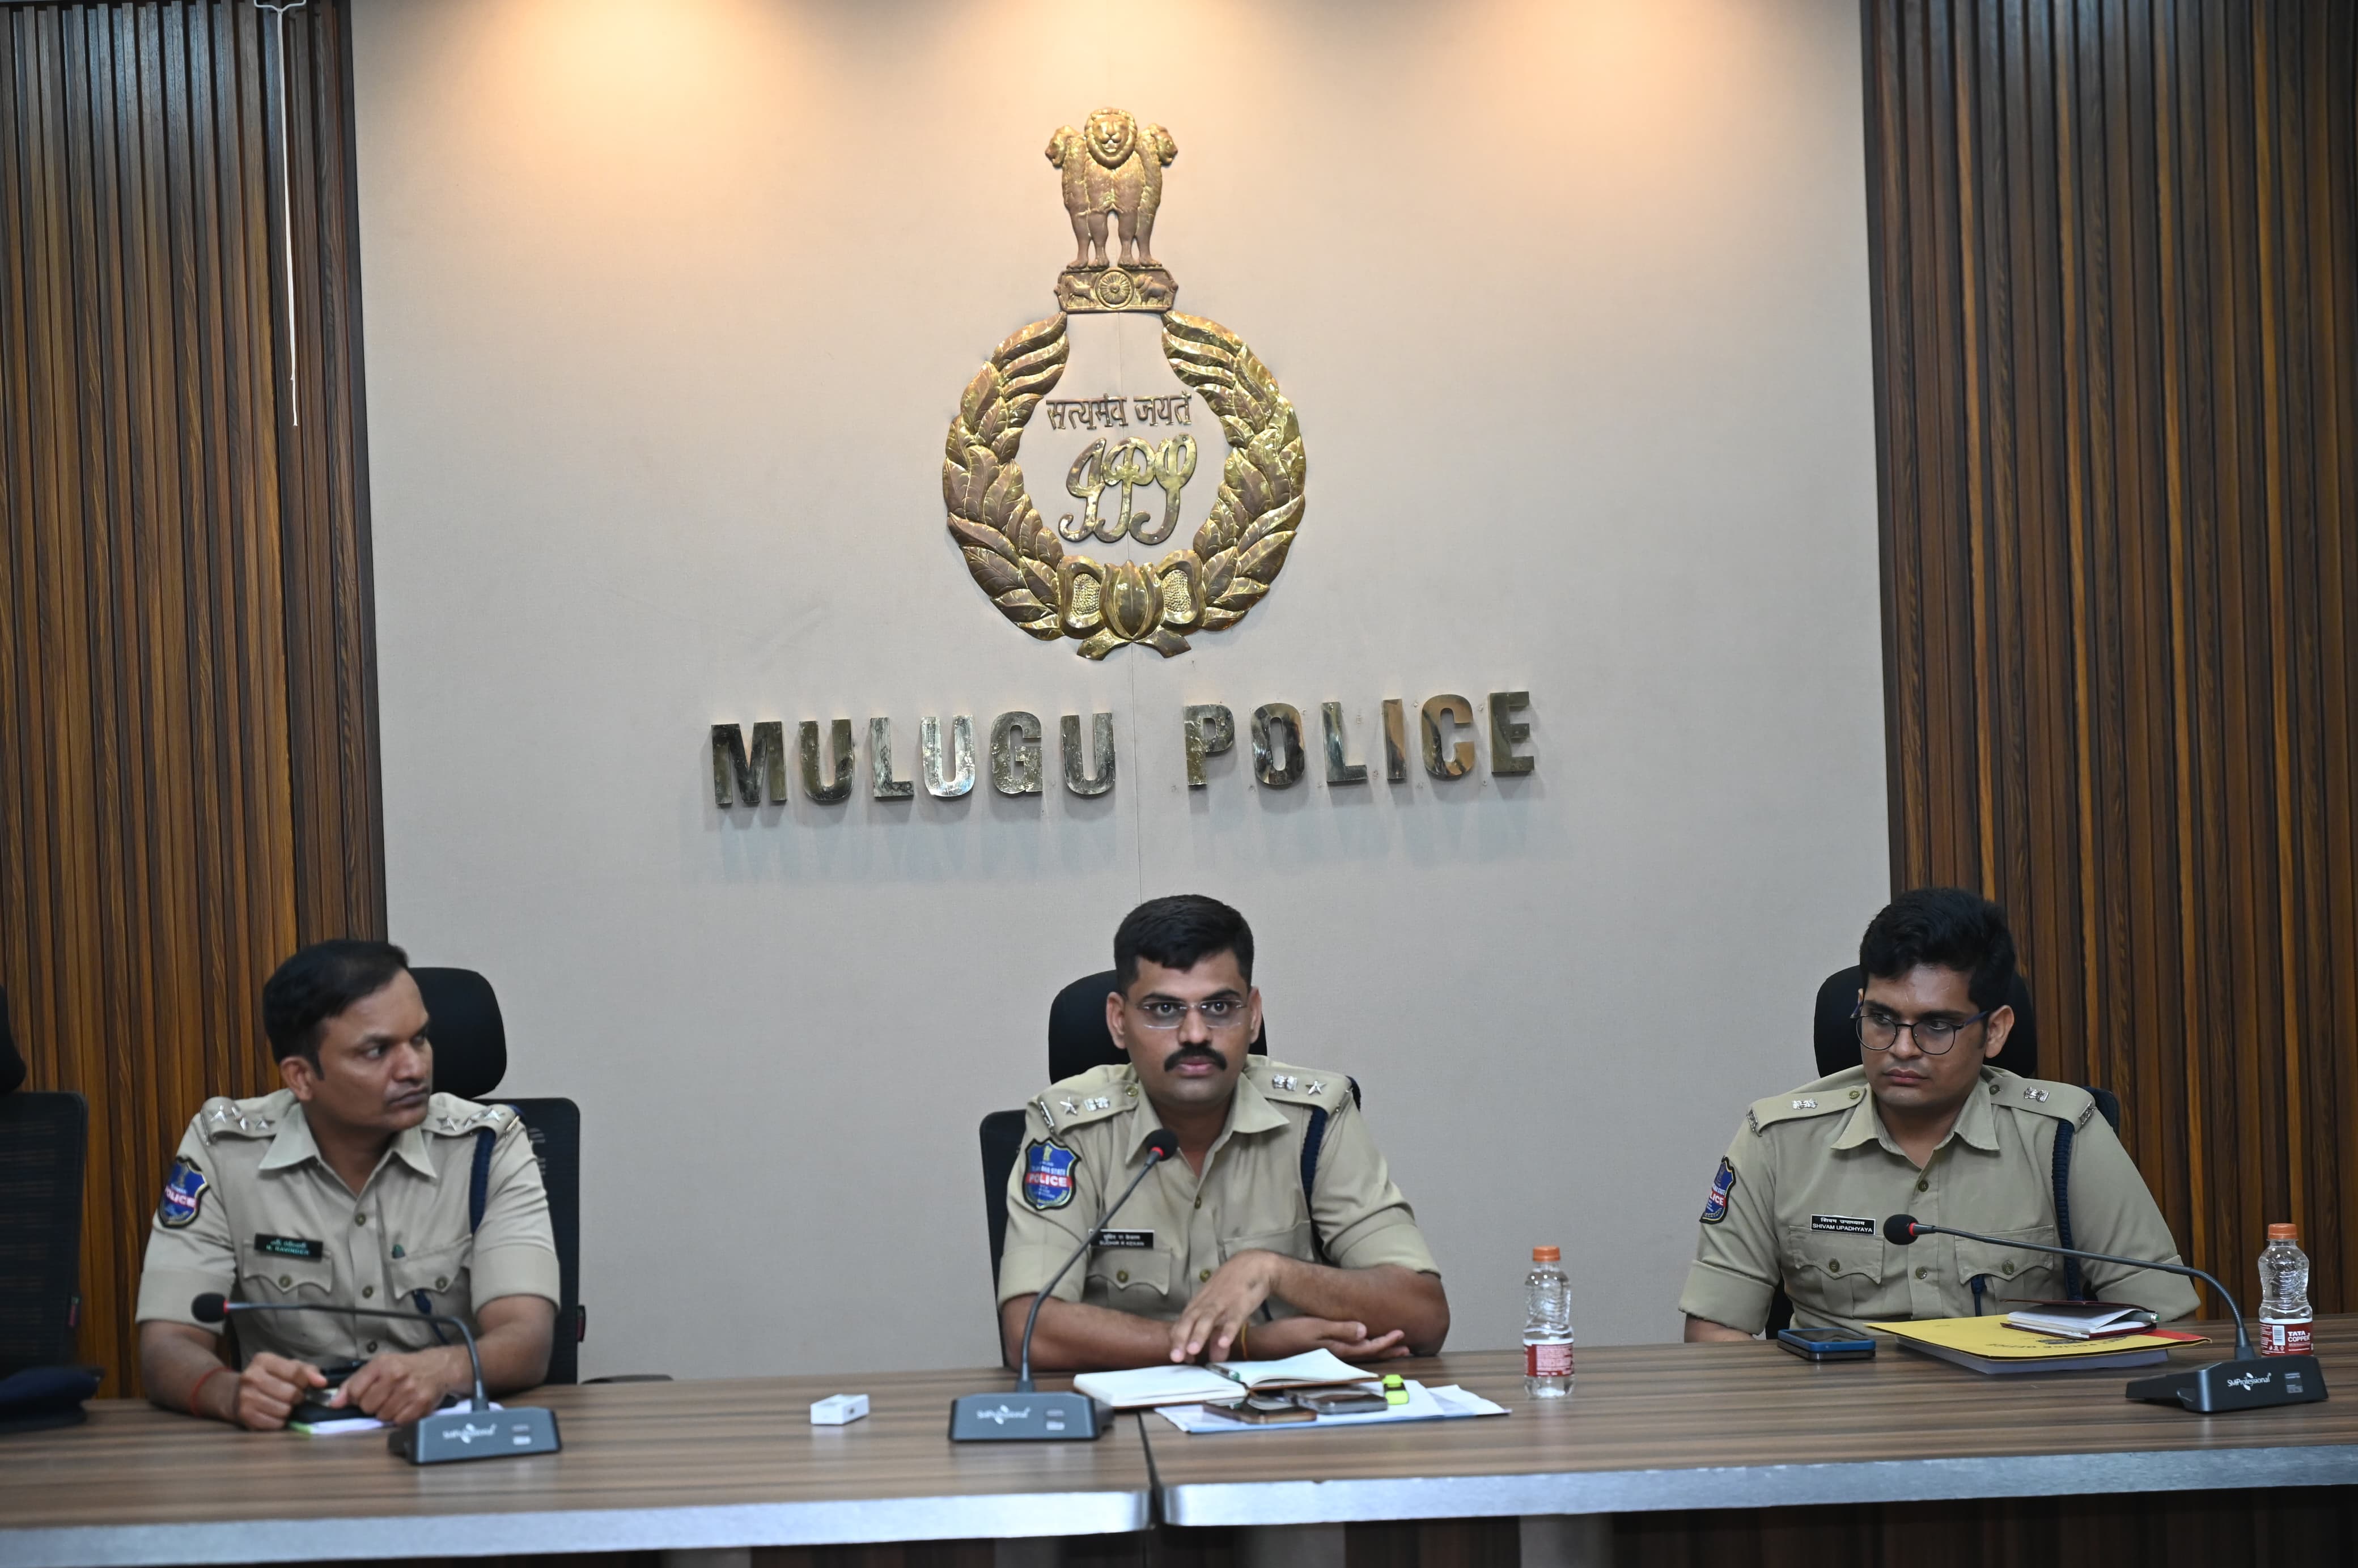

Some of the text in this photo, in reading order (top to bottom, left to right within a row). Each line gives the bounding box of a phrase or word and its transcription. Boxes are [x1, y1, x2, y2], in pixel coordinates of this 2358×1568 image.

[711, 690, 1540, 805] MULUGU POLICE
[1029, 1173, 1067, 1187] POLICE
[1836, 1225, 1873, 1233] UPADHYAYA
